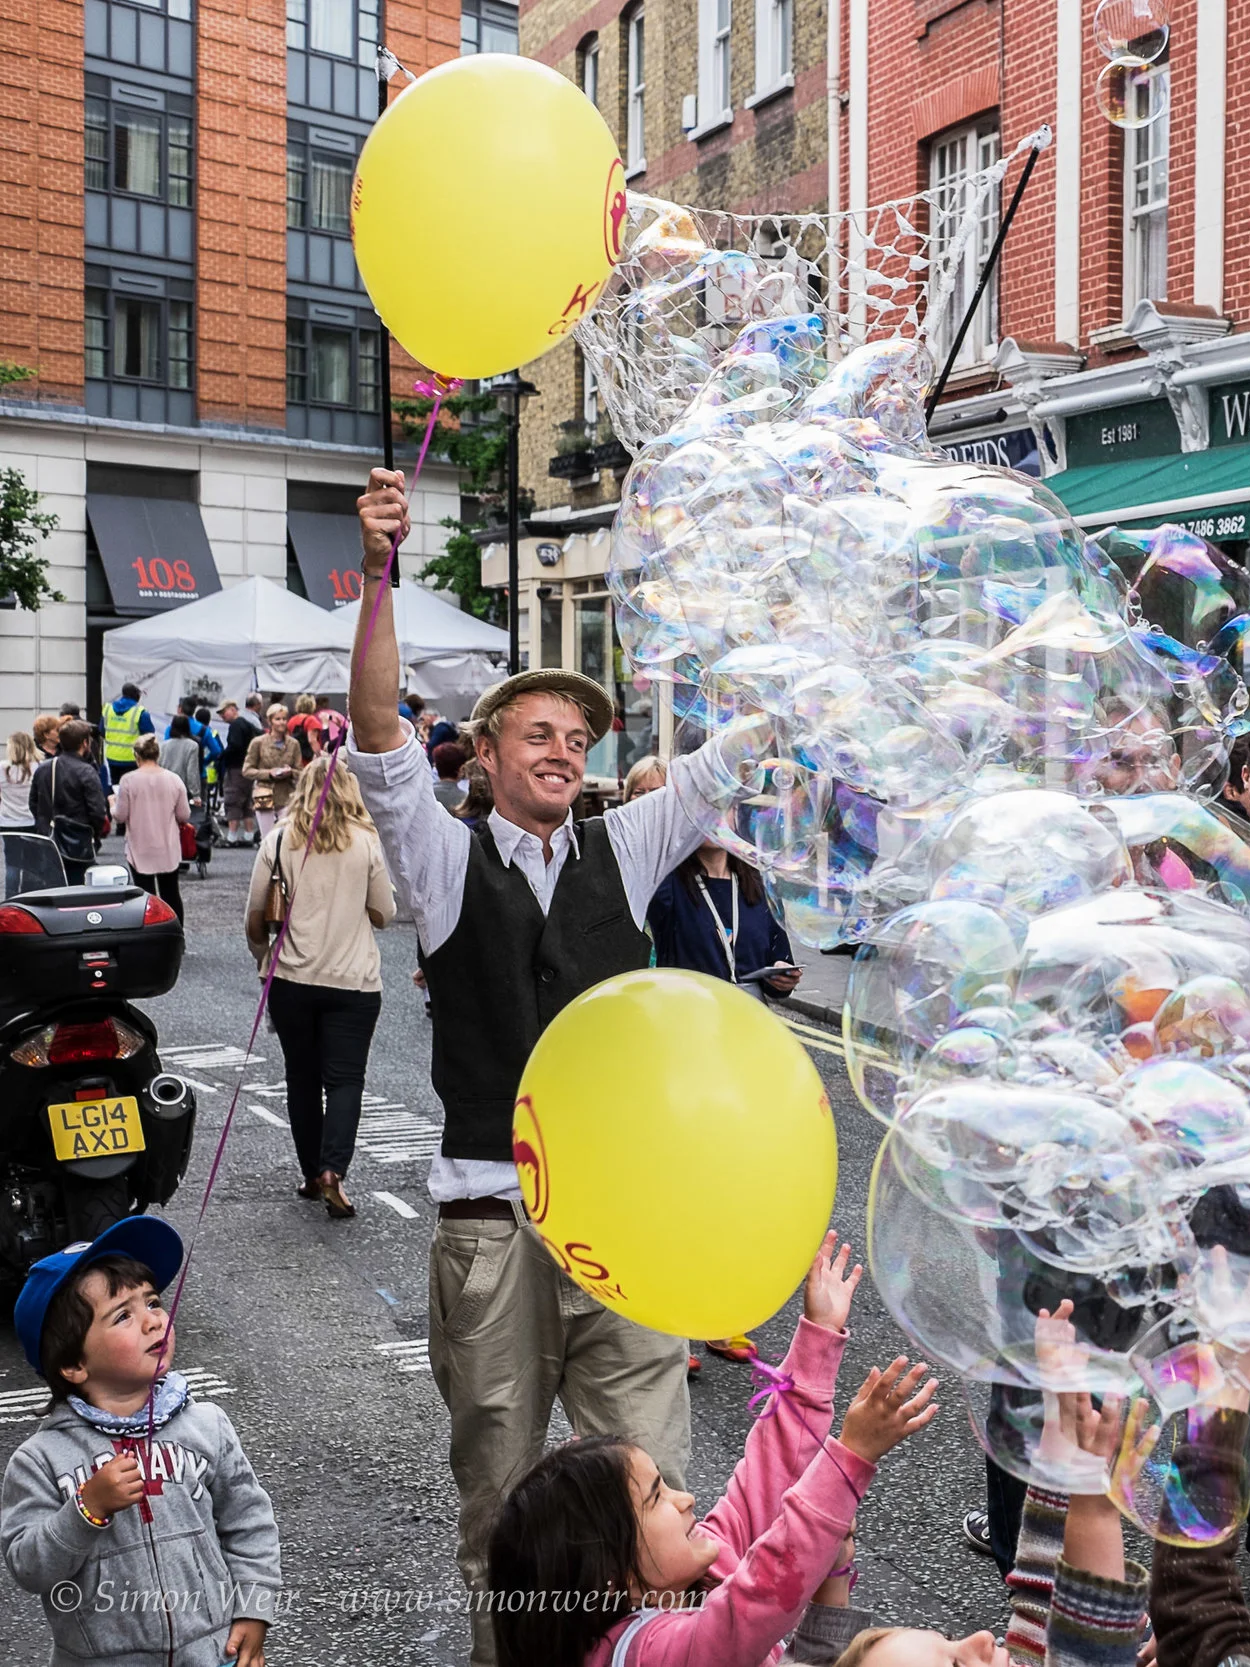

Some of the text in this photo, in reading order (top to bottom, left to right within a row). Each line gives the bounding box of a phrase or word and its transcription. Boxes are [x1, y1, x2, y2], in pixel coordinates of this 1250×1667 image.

[1101, 423, 1138, 446] Est 1981
[1187, 518, 1215, 537] 7486
[1216, 514, 1246, 536] 3862
[131, 556, 197, 592] 108
[60, 1102, 128, 1131] LG14
[72, 1127, 129, 1155] AXD
